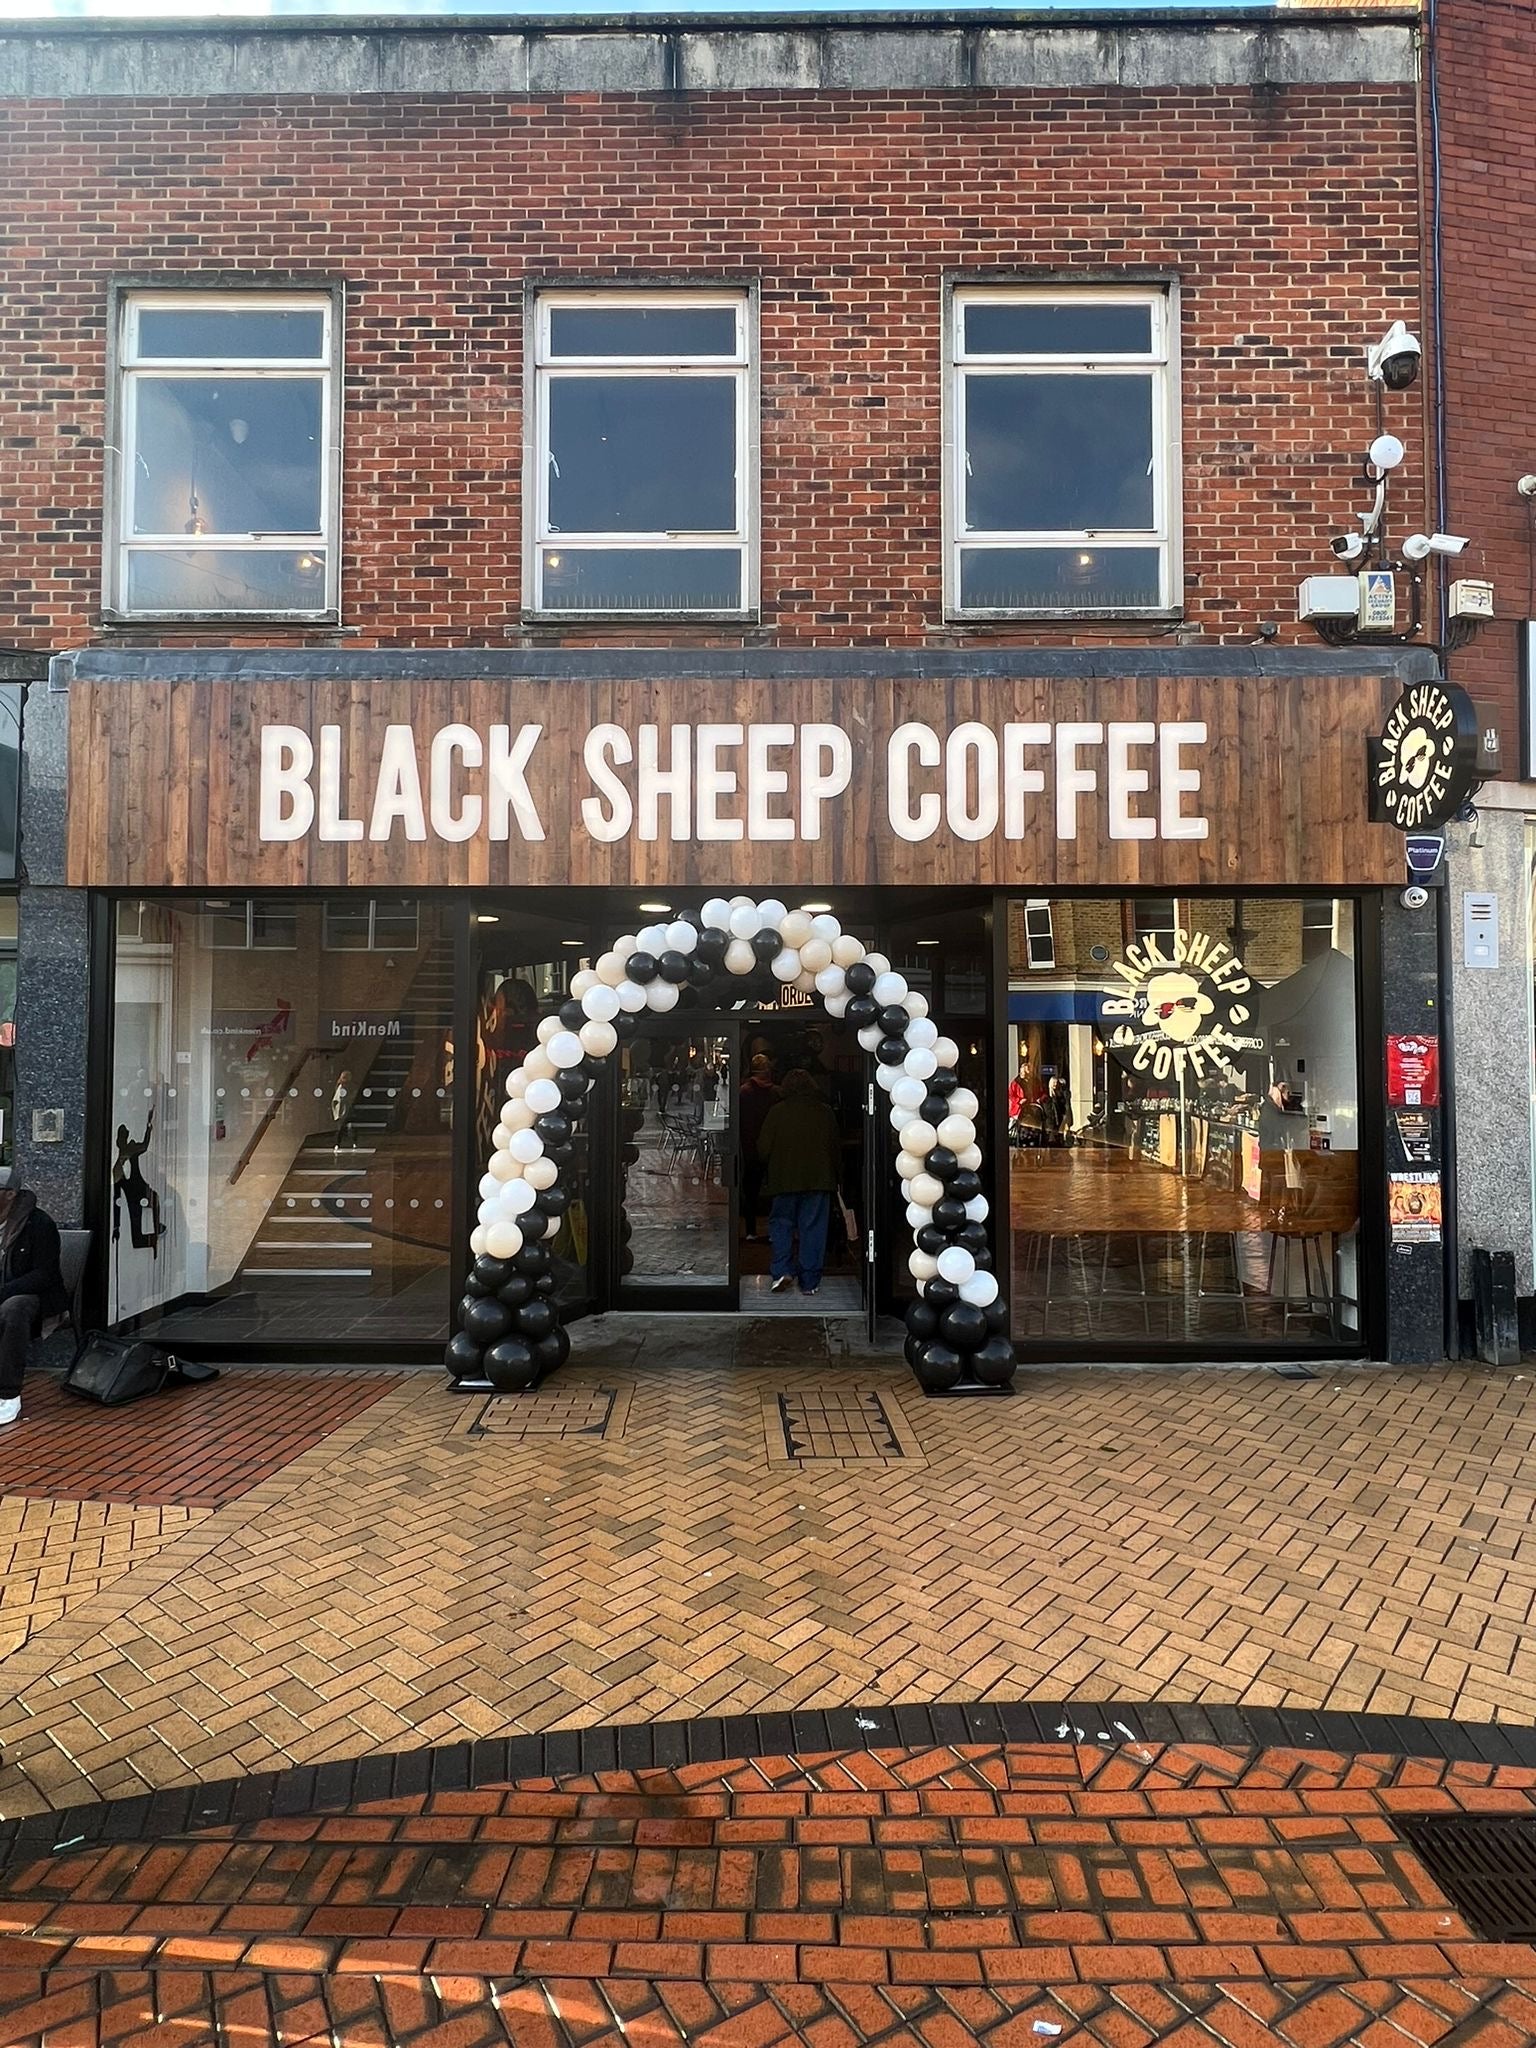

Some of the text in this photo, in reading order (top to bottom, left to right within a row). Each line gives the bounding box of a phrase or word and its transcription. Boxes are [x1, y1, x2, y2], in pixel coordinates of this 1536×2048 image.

[1379, 685, 1454, 786] BLACK SHEEP
[259, 722, 1209, 842] BLACK SHEEP COFFEE
[1396, 760, 1453, 827] COFFEE
[1102, 929, 1251, 1015] BLACK SHEEP
[1133, 1023, 1243, 1082] COFFEE
[1391, 1172, 1438, 1184] WRESTLING
